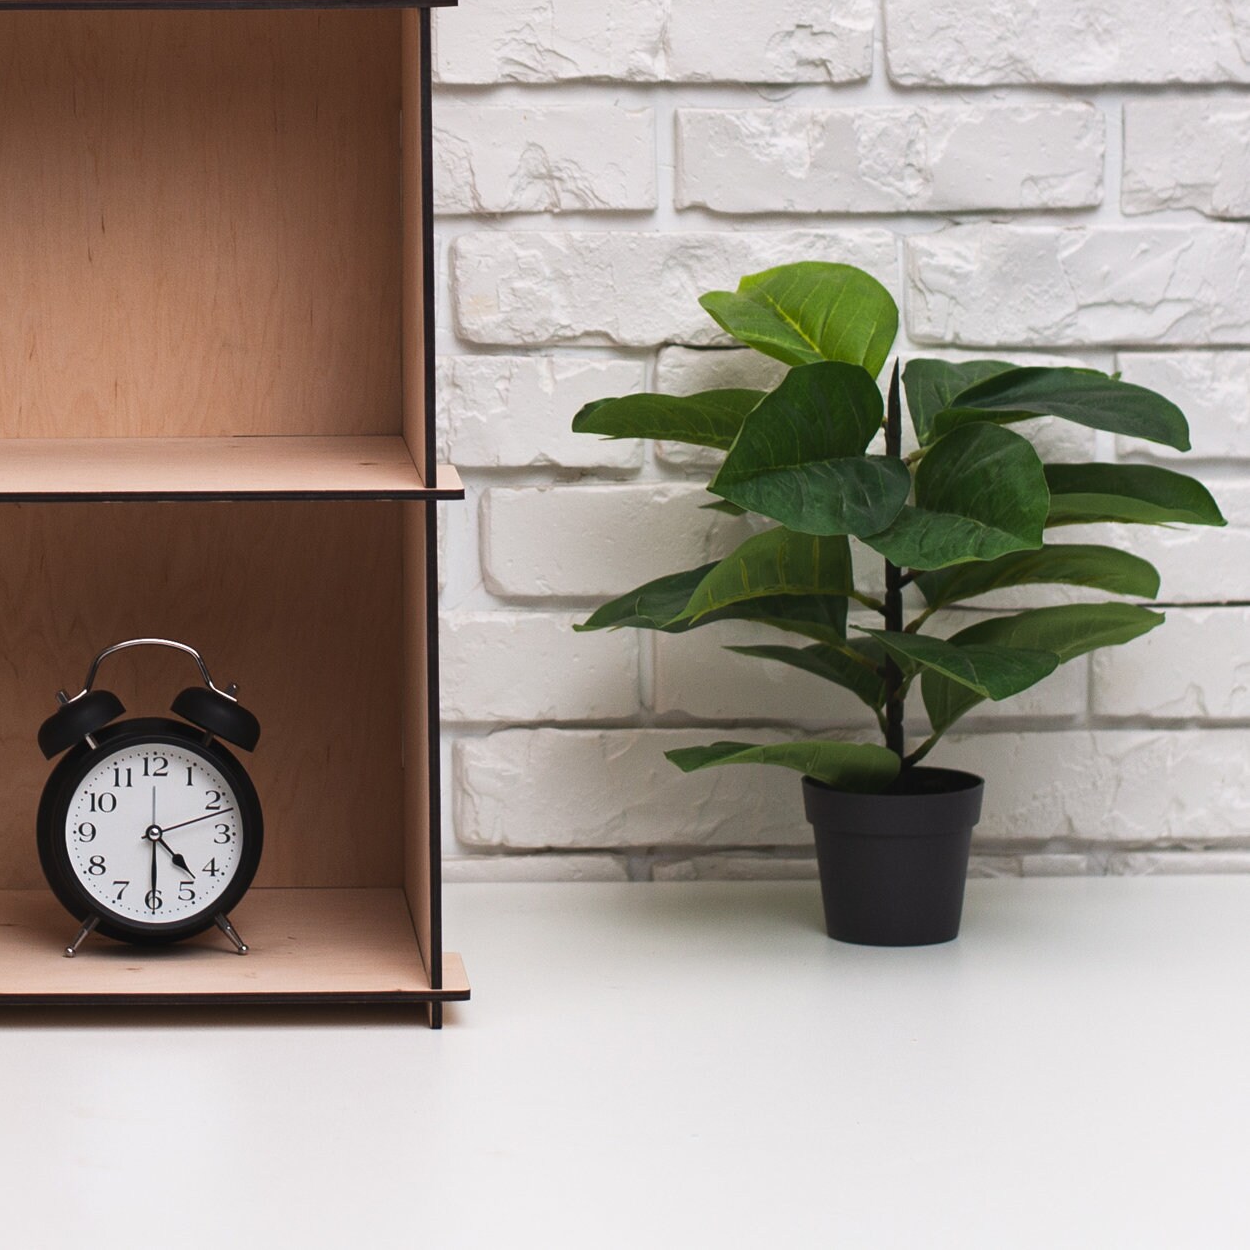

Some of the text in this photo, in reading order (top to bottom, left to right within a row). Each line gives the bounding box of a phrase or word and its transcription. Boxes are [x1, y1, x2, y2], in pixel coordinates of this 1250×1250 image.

[142, 757, 168, 776] 12
[187, 767, 193, 786] 1
[114, 767, 132, 787] 11
[89, 792, 117, 813] 10
[205, 791, 221, 810] 2
[78, 822, 96, 842] 9
[214, 824, 230, 844] 3
[88, 855, 106, 875] 8
[202, 858, 219, 876] 4
[112, 881, 129, 900] 7
[145, 890, 163, 910] 6
[178, 881, 195, 901] 5
